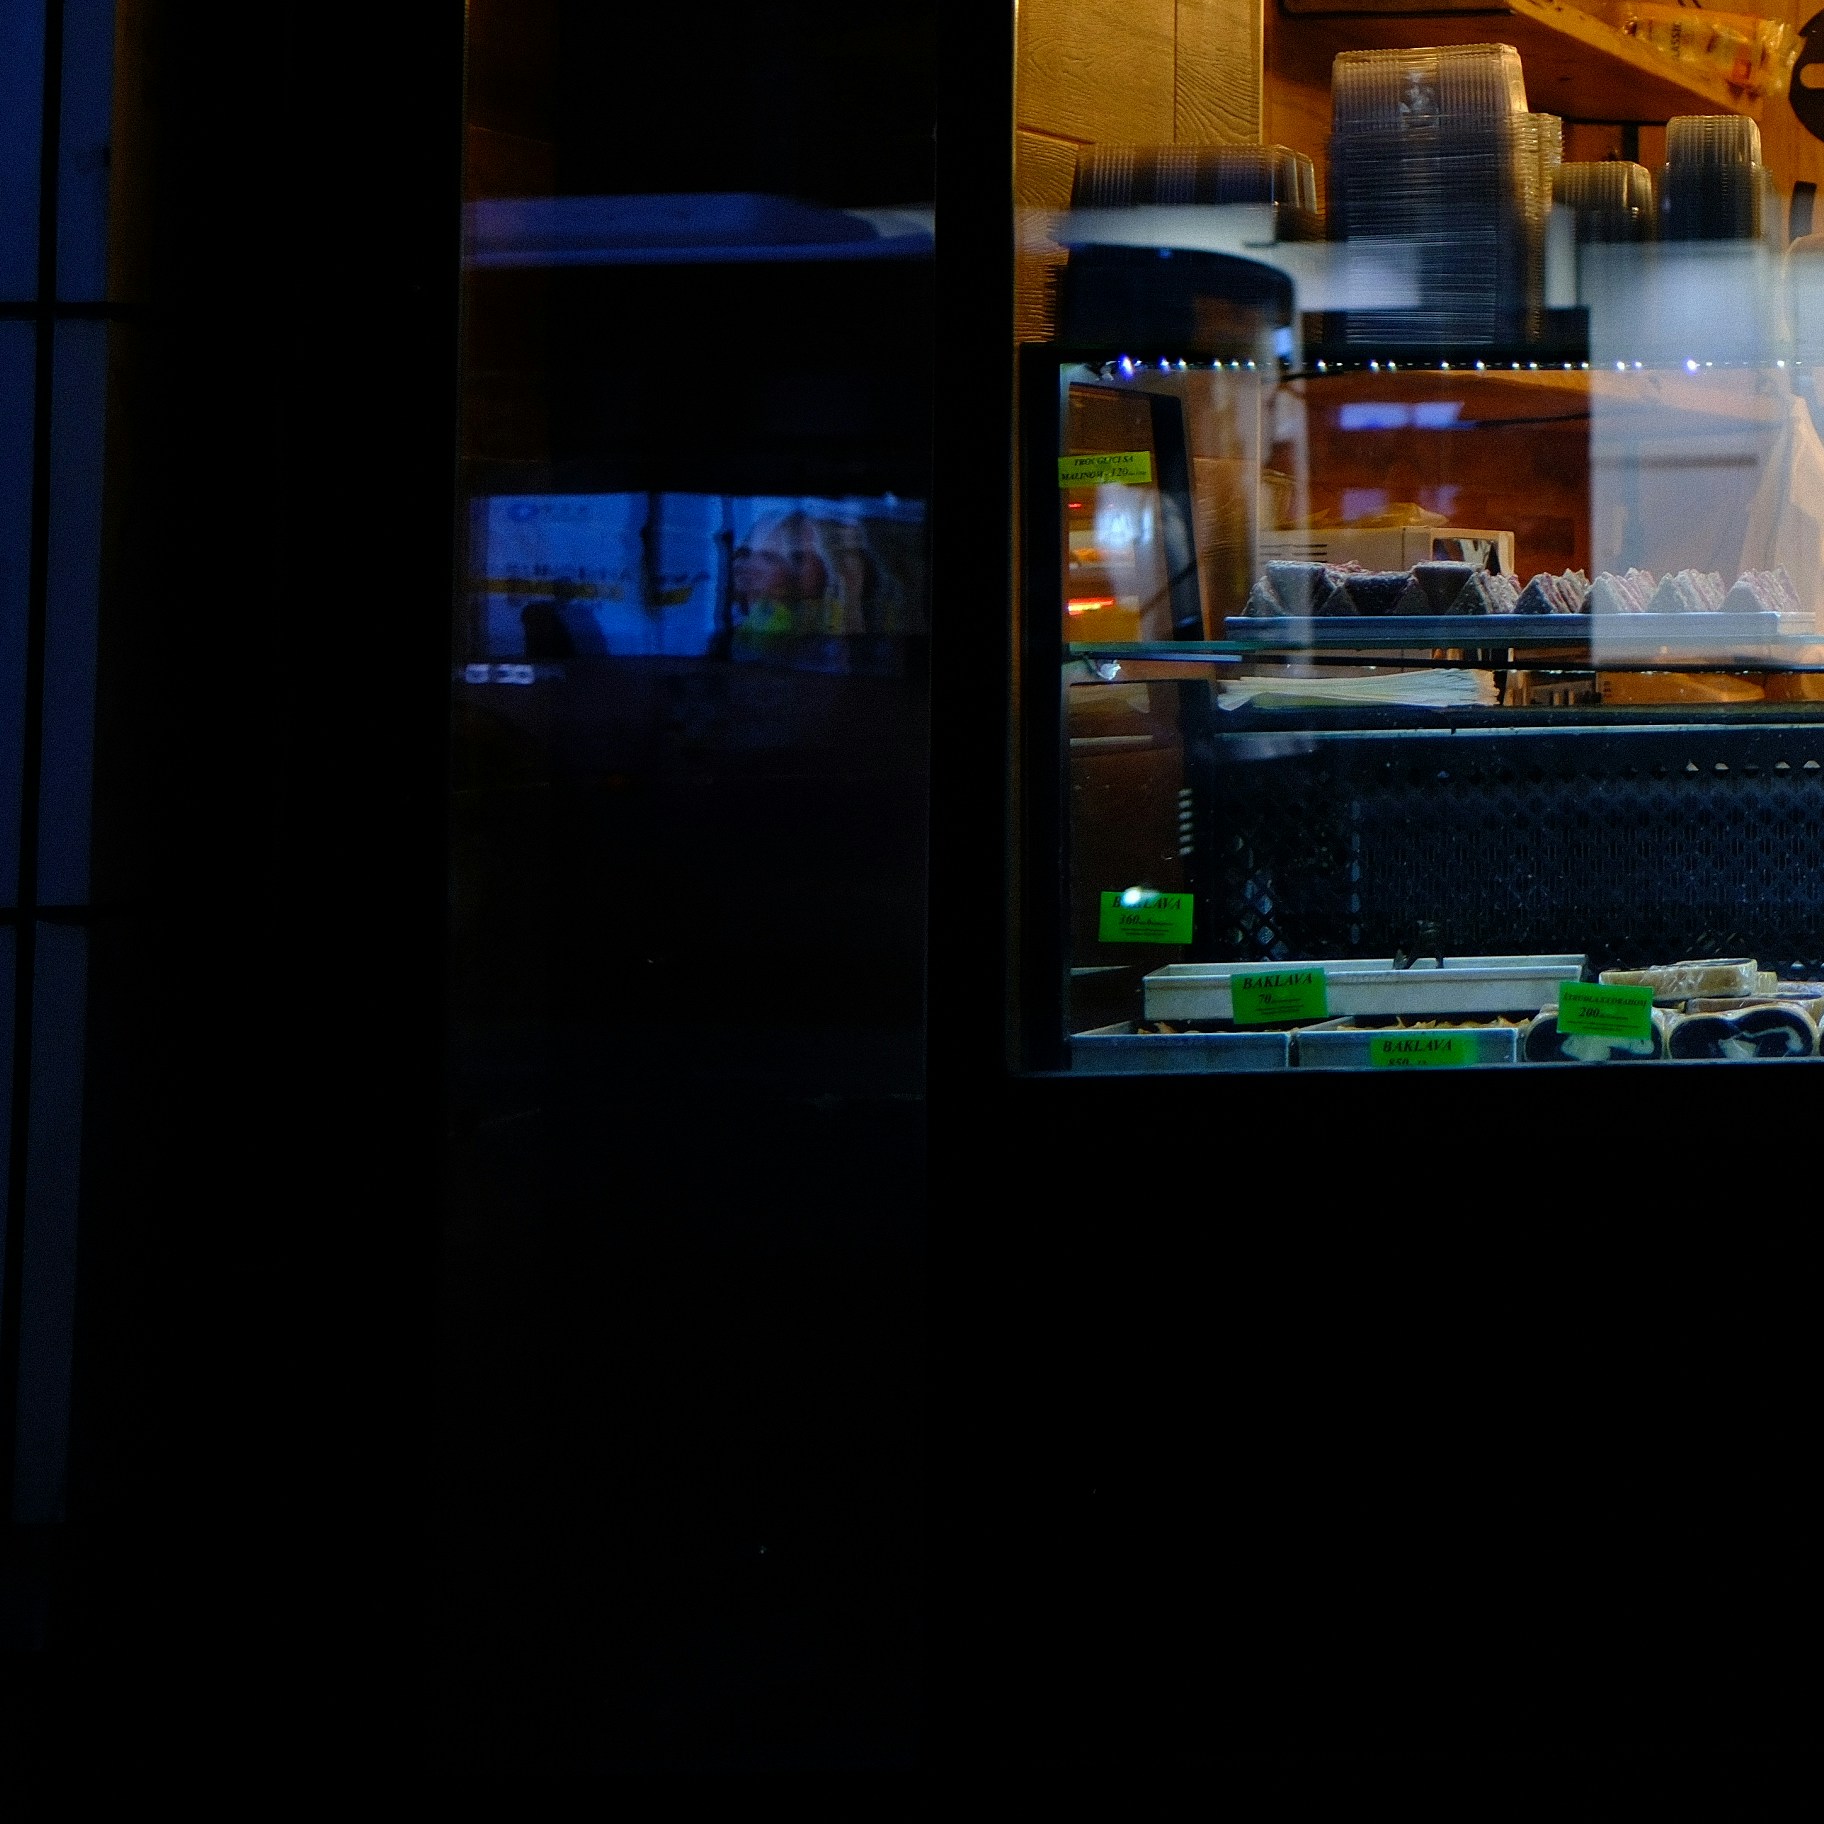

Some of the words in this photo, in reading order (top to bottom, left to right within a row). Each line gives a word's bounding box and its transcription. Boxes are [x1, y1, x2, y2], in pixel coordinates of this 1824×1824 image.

[1112, 895, 1181, 910] BLAVA
[1243, 973, 1312, 990] BAKLAVA
[1578, 1007, 1600, 1018] 200
[1383, 1039, 1452, 1053] BAKLAVA
